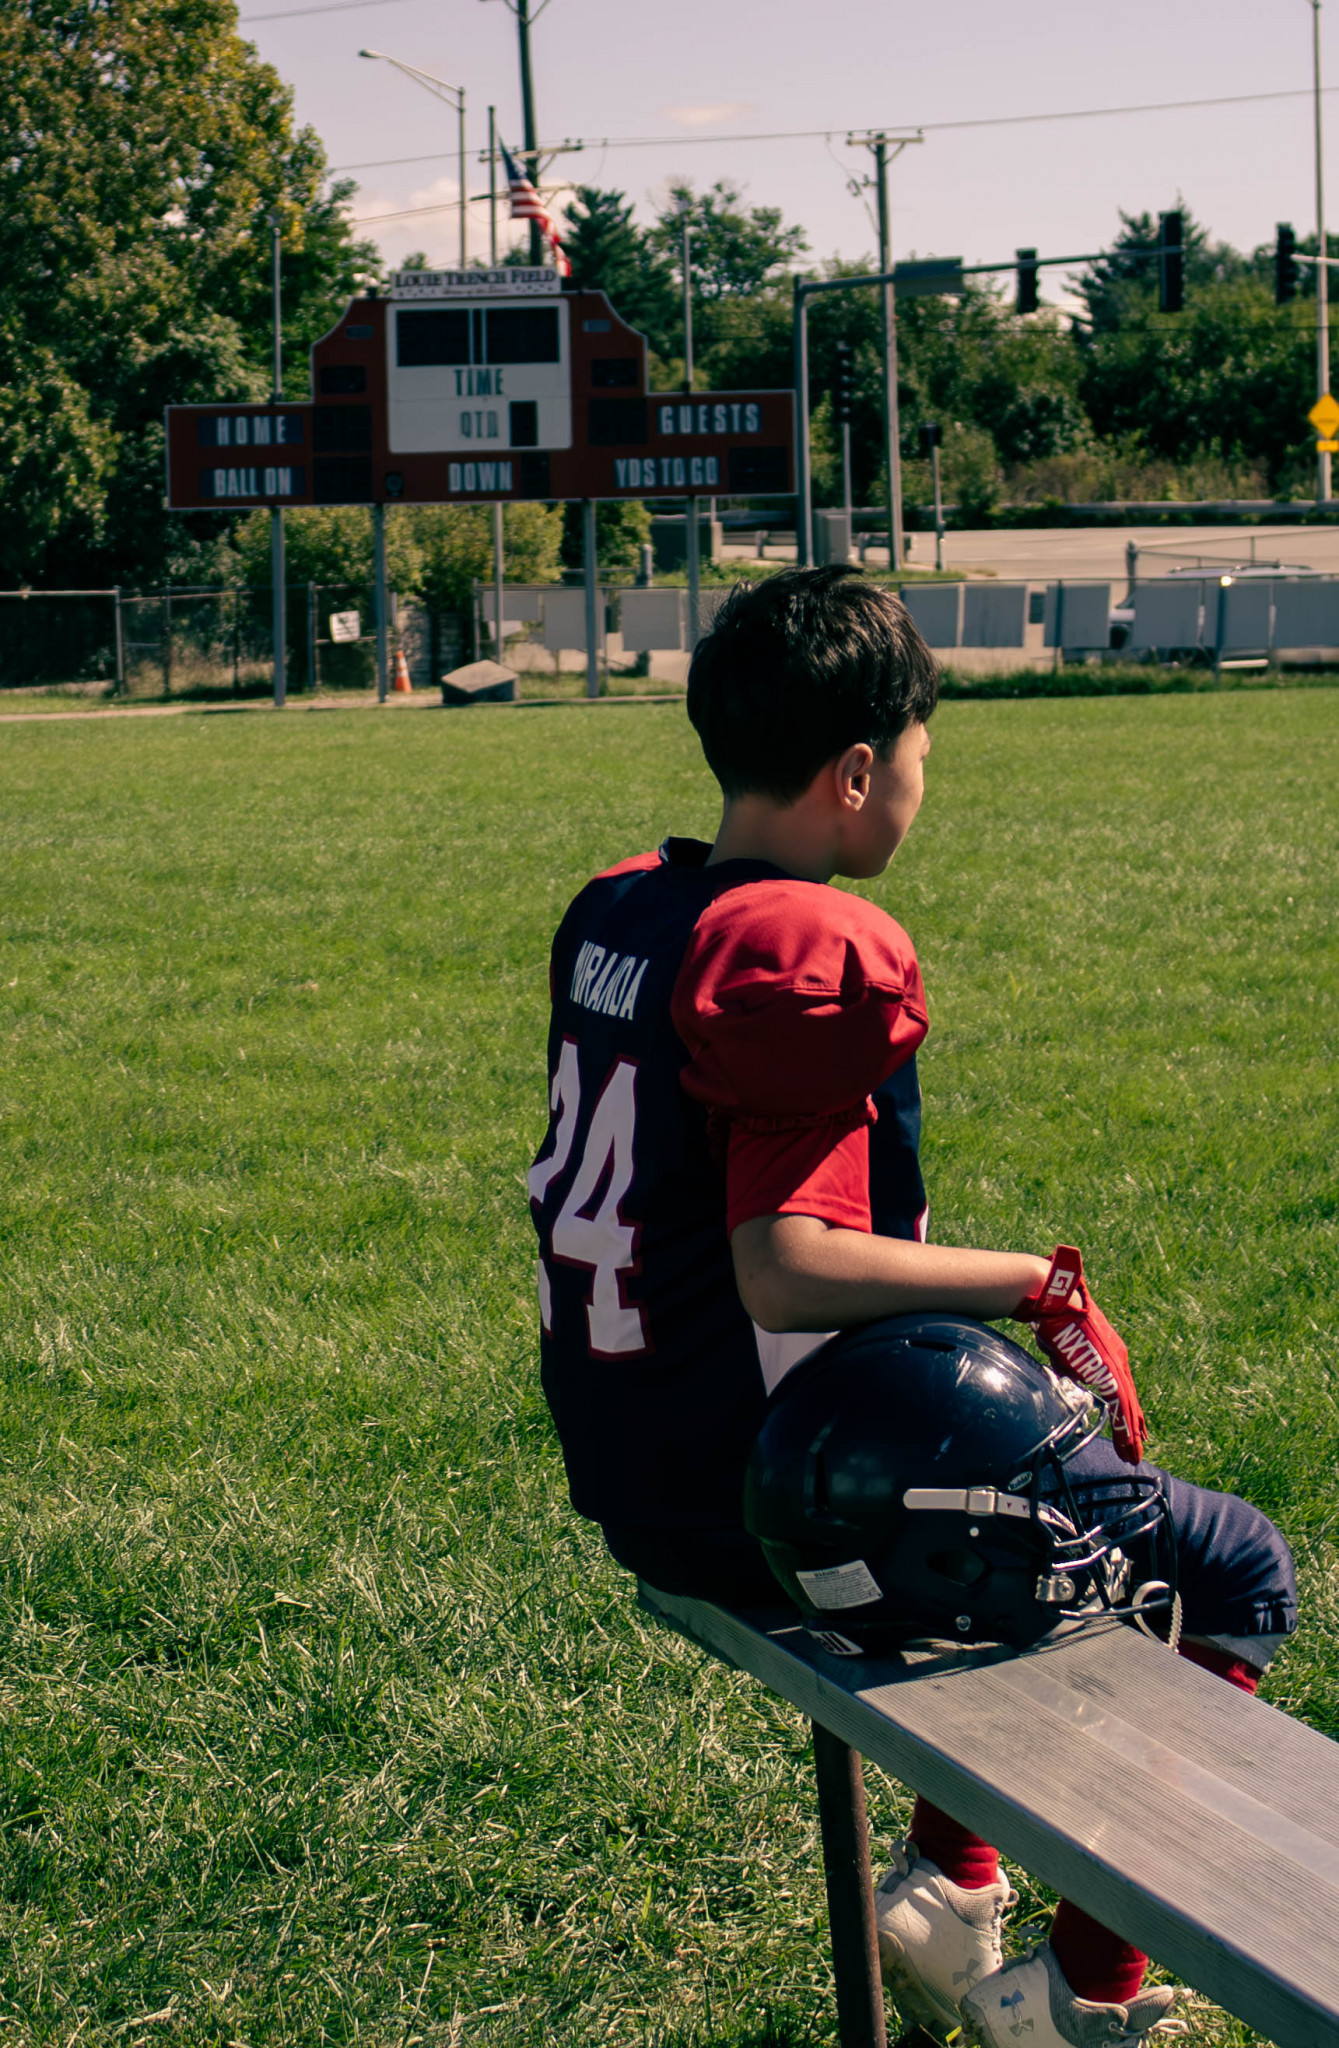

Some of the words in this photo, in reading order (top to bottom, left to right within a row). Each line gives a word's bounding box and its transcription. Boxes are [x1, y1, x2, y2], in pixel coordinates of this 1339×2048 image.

[395, 274, 442, 288] LOUIE
[511, 269, 557, 283] FIELD
[454, 368, 503, 396] TIME
[217, 415, 286, 446] HOME
[460, 411, 498, 438] QTR
[660, 403, 760, 435] GUESTS
[214, 467, 259, 497] BALL
[264, 466, 292, 496] ON
[448, 462, 513, 491] DOWN
[615, 458, 656, 488] YDS
[660, 457, 686, 487] TO
[690, 456, 718, 486] GO
[527, 1036, 647, 1356] 24
[1052, 1322, 1119, 1396] NXTRND
